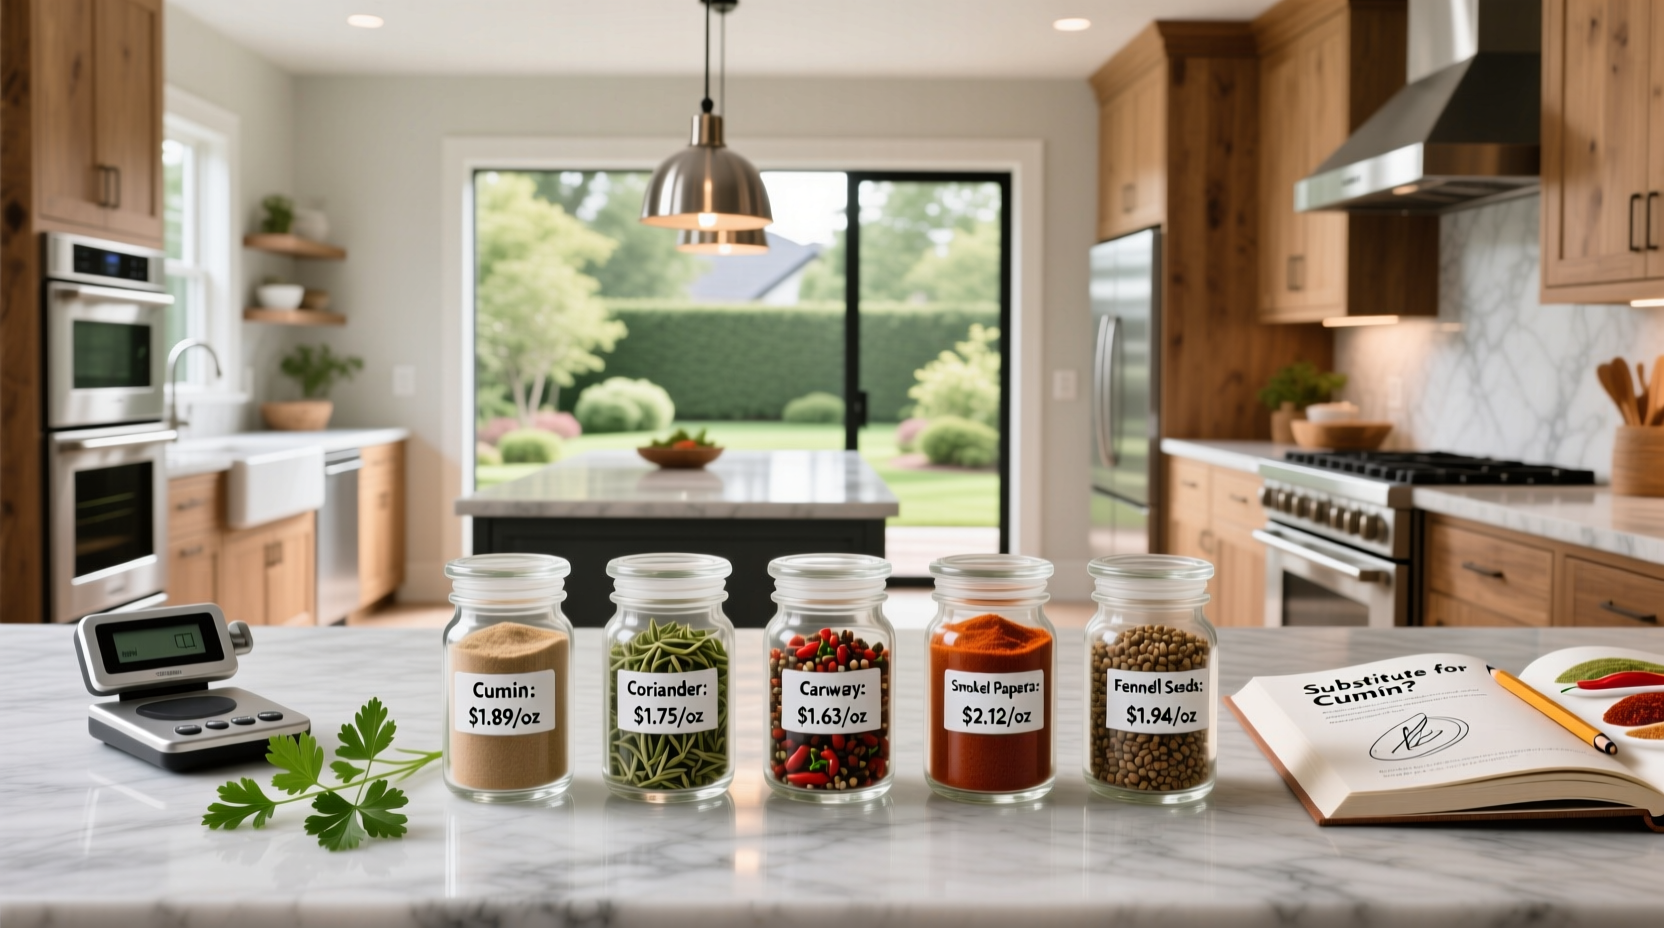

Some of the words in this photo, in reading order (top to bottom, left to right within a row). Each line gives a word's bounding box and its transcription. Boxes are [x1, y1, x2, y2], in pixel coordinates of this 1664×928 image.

[473, 681, 536, 698] Cumin:
[627, 680, 707, 697] Coriander:
[1303, 670, 1427, 695] Substitute
[1434, 663, 1467, 674] for
[1313, 681, 1416, 706] Cumin?
[469, 706, 541, 728] $1.89/oz
[634, 705, 704, 728] $1.75/oz
[797, 706, 868, 727] $1.63/oz
[962, 705, 1032, 727] $2.12/oz
[1126, 705, 1197, 727] $1.94/oz
